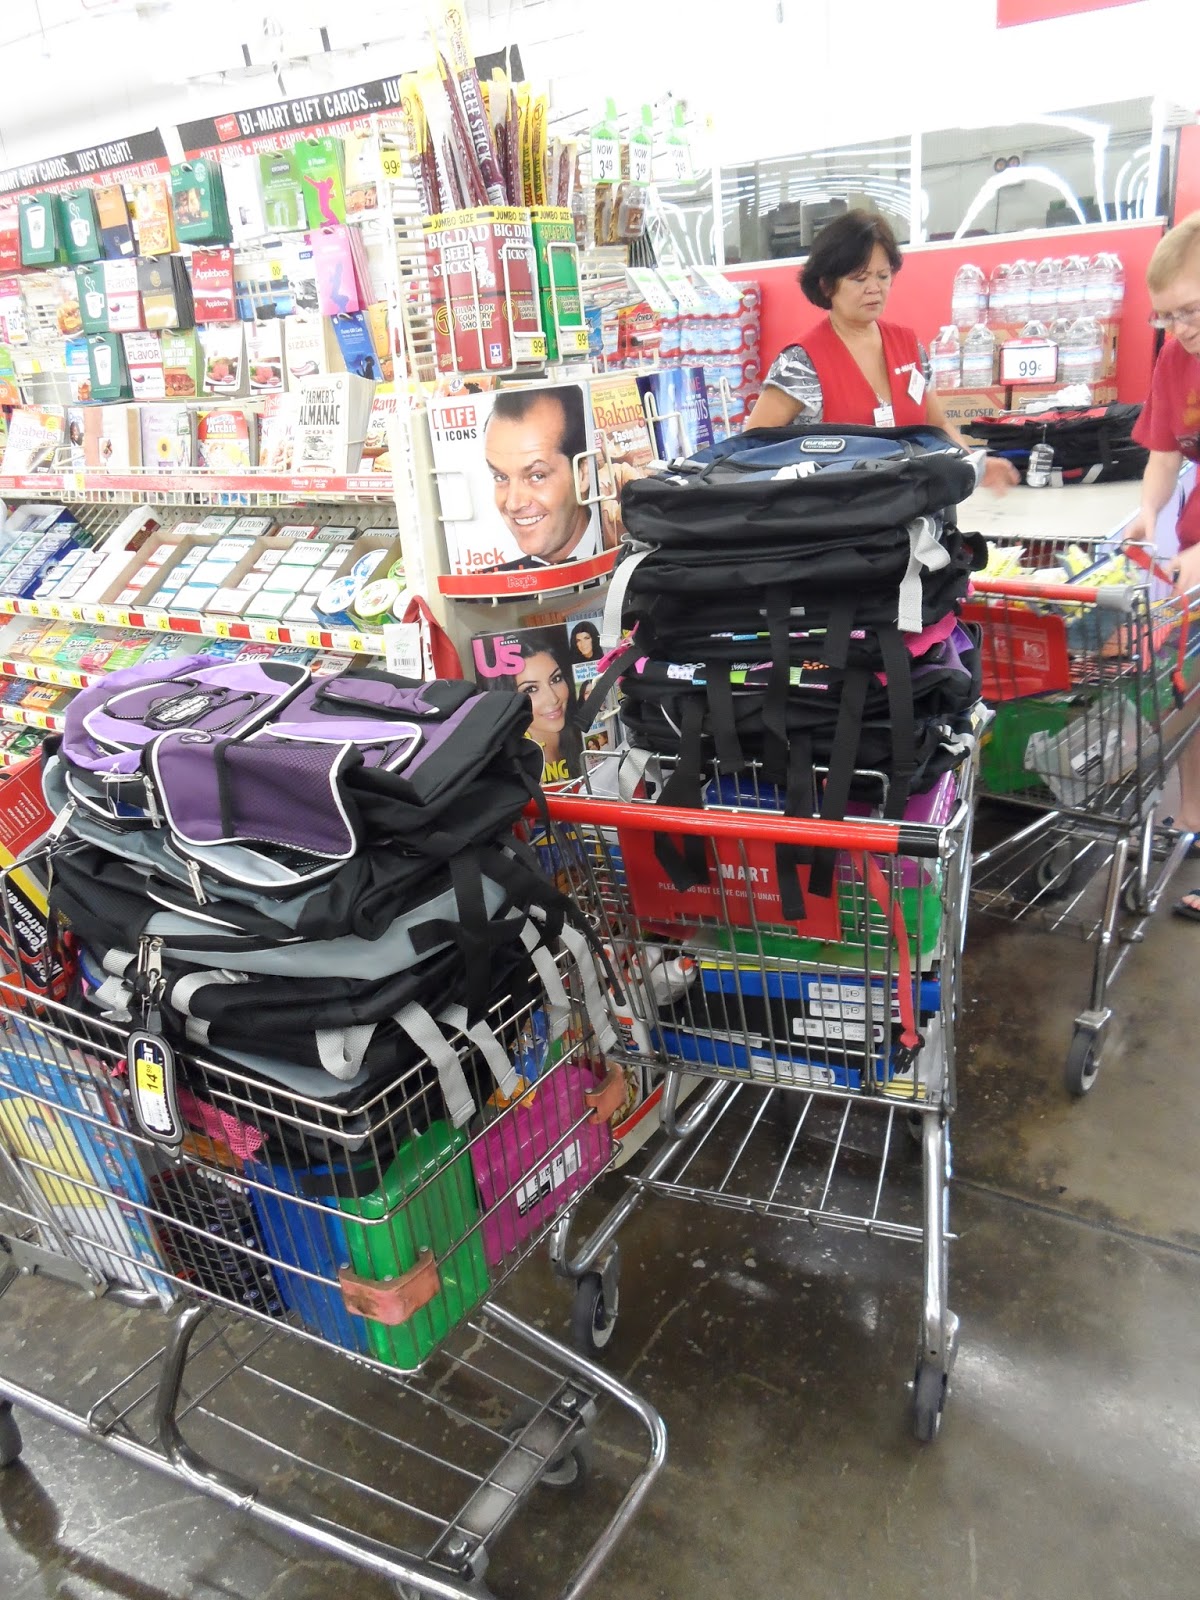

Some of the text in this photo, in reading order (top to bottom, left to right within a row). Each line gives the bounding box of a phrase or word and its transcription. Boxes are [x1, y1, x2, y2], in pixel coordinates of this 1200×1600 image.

[238, 104, 290, 135] BI-MART
[292, 98, 322, 123] GIFT
[382, 79, 401, 105] JU
[460, 79, 493, 165] BEEF STICK
[596, 145, 613, 155] NOW
[634, 149, 648, 158] NOW
[19, 164, 40, 187] GIFT
[77, 150, 100, 173] JUST
[98, 141, 134, 167] RIGHT!
[434, 213, 474, 229] JUMBO SIZE
[496, 211, 517, 221] JUMBO
[540, 210, 570, 221] JUMBO SIZE
[427, 224, 490, 249] BIG DAD
[493, 224, 513, 237] BIG
[444, 246, 470, 262] BEEF
[432, 260, 471, 277] STICKS
[461, 320, 491, 331] SMOER
[298, 404, 341, 426] ALMANAC
[441, 406, 477, 429] LIFE
[594, 400, 646, 429] Baking
[945, 408, 994, 419] STAL GEYSER
[446, 429, 477, 442] ICONS
[465, 547, 506, 566] Jack
[507, 575, 537, 588] People
[472, 636, 526, 678] Us
[709, 863, 769, 883] -MART
[658, 881, 679, 892] PLEA
[697, 885, 711, 895] NOT
[713, 887, 733, 896] LEVE
[757, 892, 781, 902] UNATT
[15, 920, 40, 952] Texas
